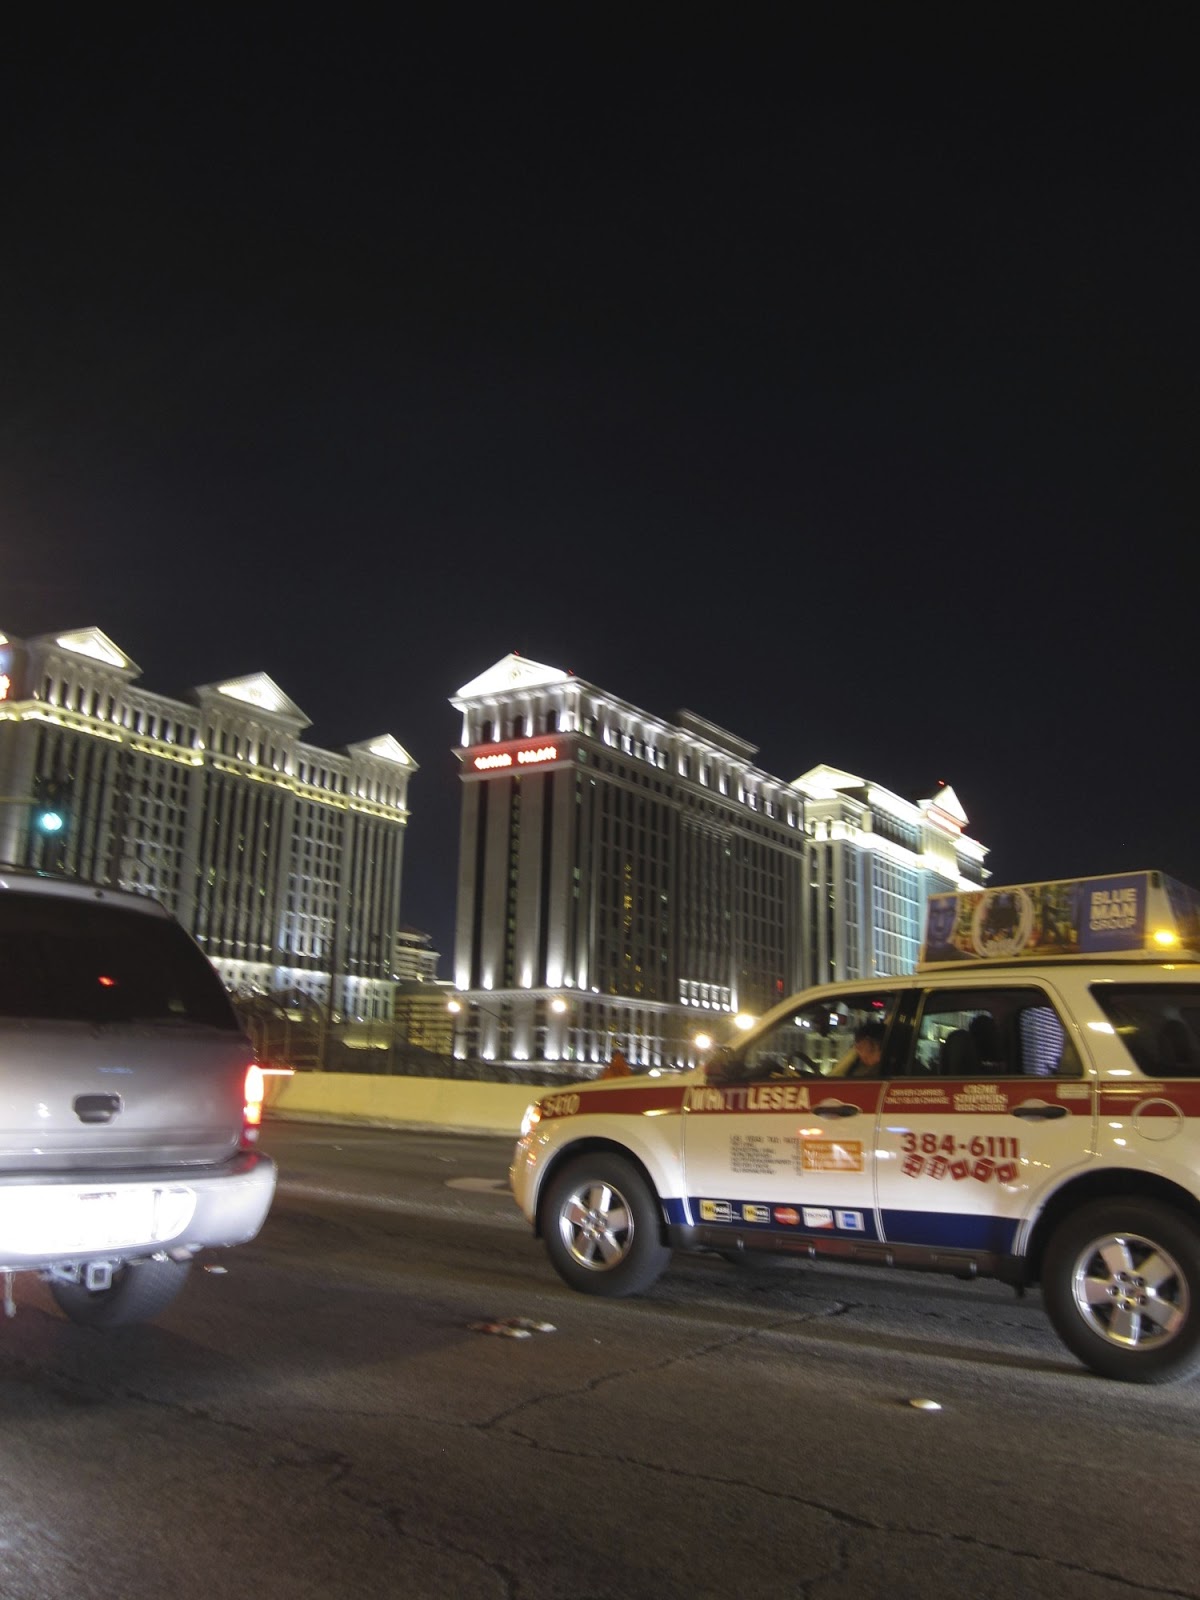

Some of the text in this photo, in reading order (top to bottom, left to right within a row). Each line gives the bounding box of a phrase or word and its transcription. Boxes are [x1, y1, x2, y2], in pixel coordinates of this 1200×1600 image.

[1091, 888, 1137, 905] BLUE
[1090, 903, 1136, 920] MAN
[1089, 917, 1137, 931] GROUP
[901, 1132, 1019, 1159] 384-6111
